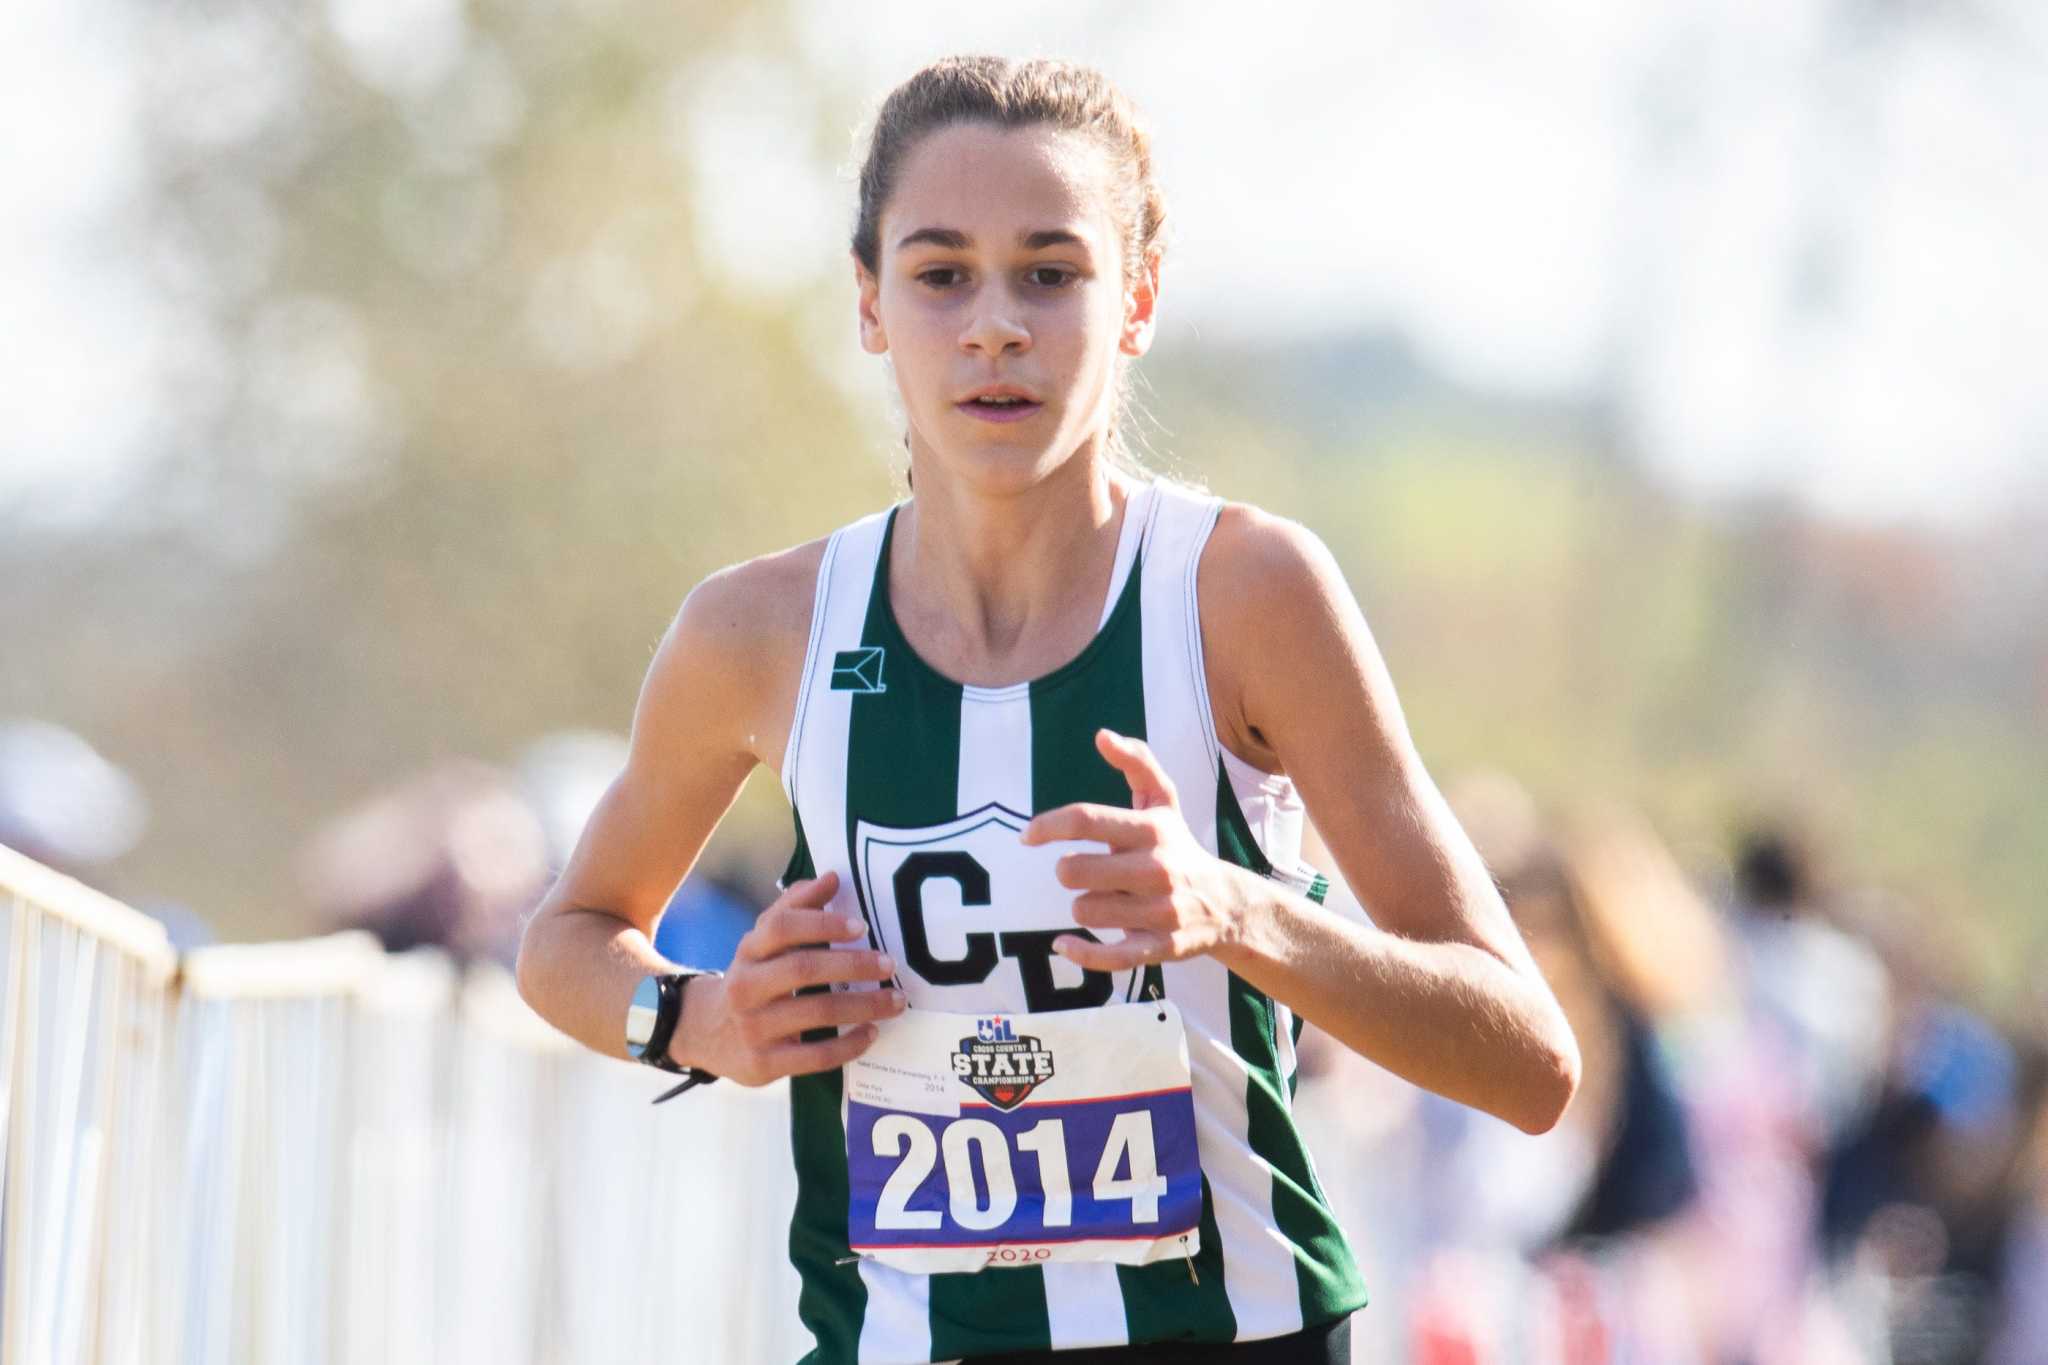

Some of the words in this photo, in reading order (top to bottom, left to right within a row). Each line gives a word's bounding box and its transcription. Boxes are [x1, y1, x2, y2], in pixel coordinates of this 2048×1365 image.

[995, 1043, 1027, 1053] COUNTRY
[953, 1052, 1052, 1076] STATE
[972, 1075, 1035, 1085] CHAMPIONSHIPS
[871, 1109, 1168, 1231] 2014
[986, 1247, 1052, 1262] 2020
